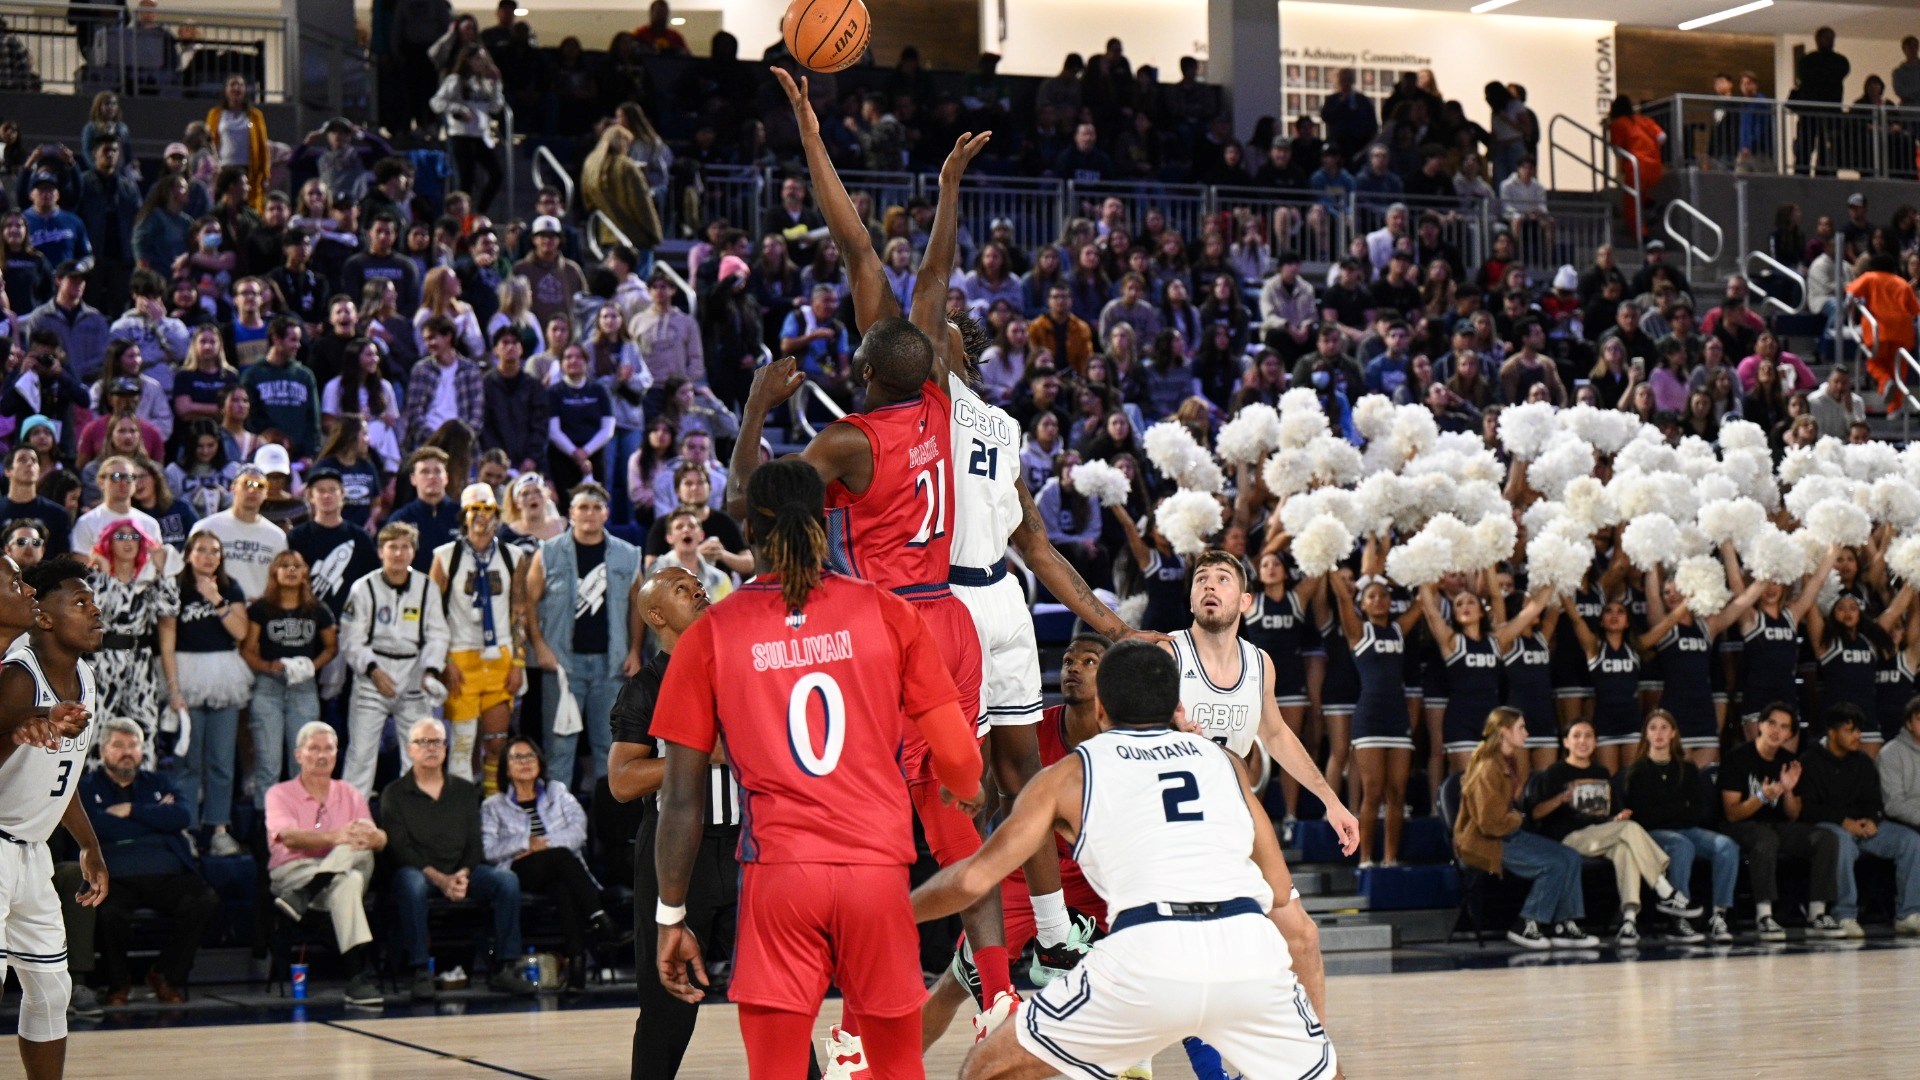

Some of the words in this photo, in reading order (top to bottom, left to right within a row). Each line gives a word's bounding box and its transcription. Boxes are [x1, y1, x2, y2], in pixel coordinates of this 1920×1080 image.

[834, 19, 858, 53] EVO
[1302, 49, 1357, 63] Advisory
[1361, 51, 1432, 65] Committee
[1597, 36, 1612, 116] WOME
[954, 398, 1011, 446] CBU
[968, 437, 998, 481] 21
[903, 458, 946, 548] 21
[234, 541, 260, 552] CBU
[225, 552, 254, 562] ANCE
[267, 617, 316, 642] CBU
[1262, 614, 1294, 629] CBU
[1765, 627, 1794, 641] CBU
[752, 630, 852, 672] SULLIVAN
[1374, 639, 1404, 654] CBU
[1678, 637, 1707, 652] CBU
[1465, 653, 1497, 667] CBU
[1523, 650, 1550, 665] CBU
[1602, 659, 1634, 673] CBU
[1843, 649, 1872, 664] CBU
[786, 671, 846, 778] 0
[1192, 703, 1249, 731] CBU
[1116, 741, 1203, 761] QUINTANA
[50, 760, 73, 797] 3
[1158, 770, 1204, 822] 2
